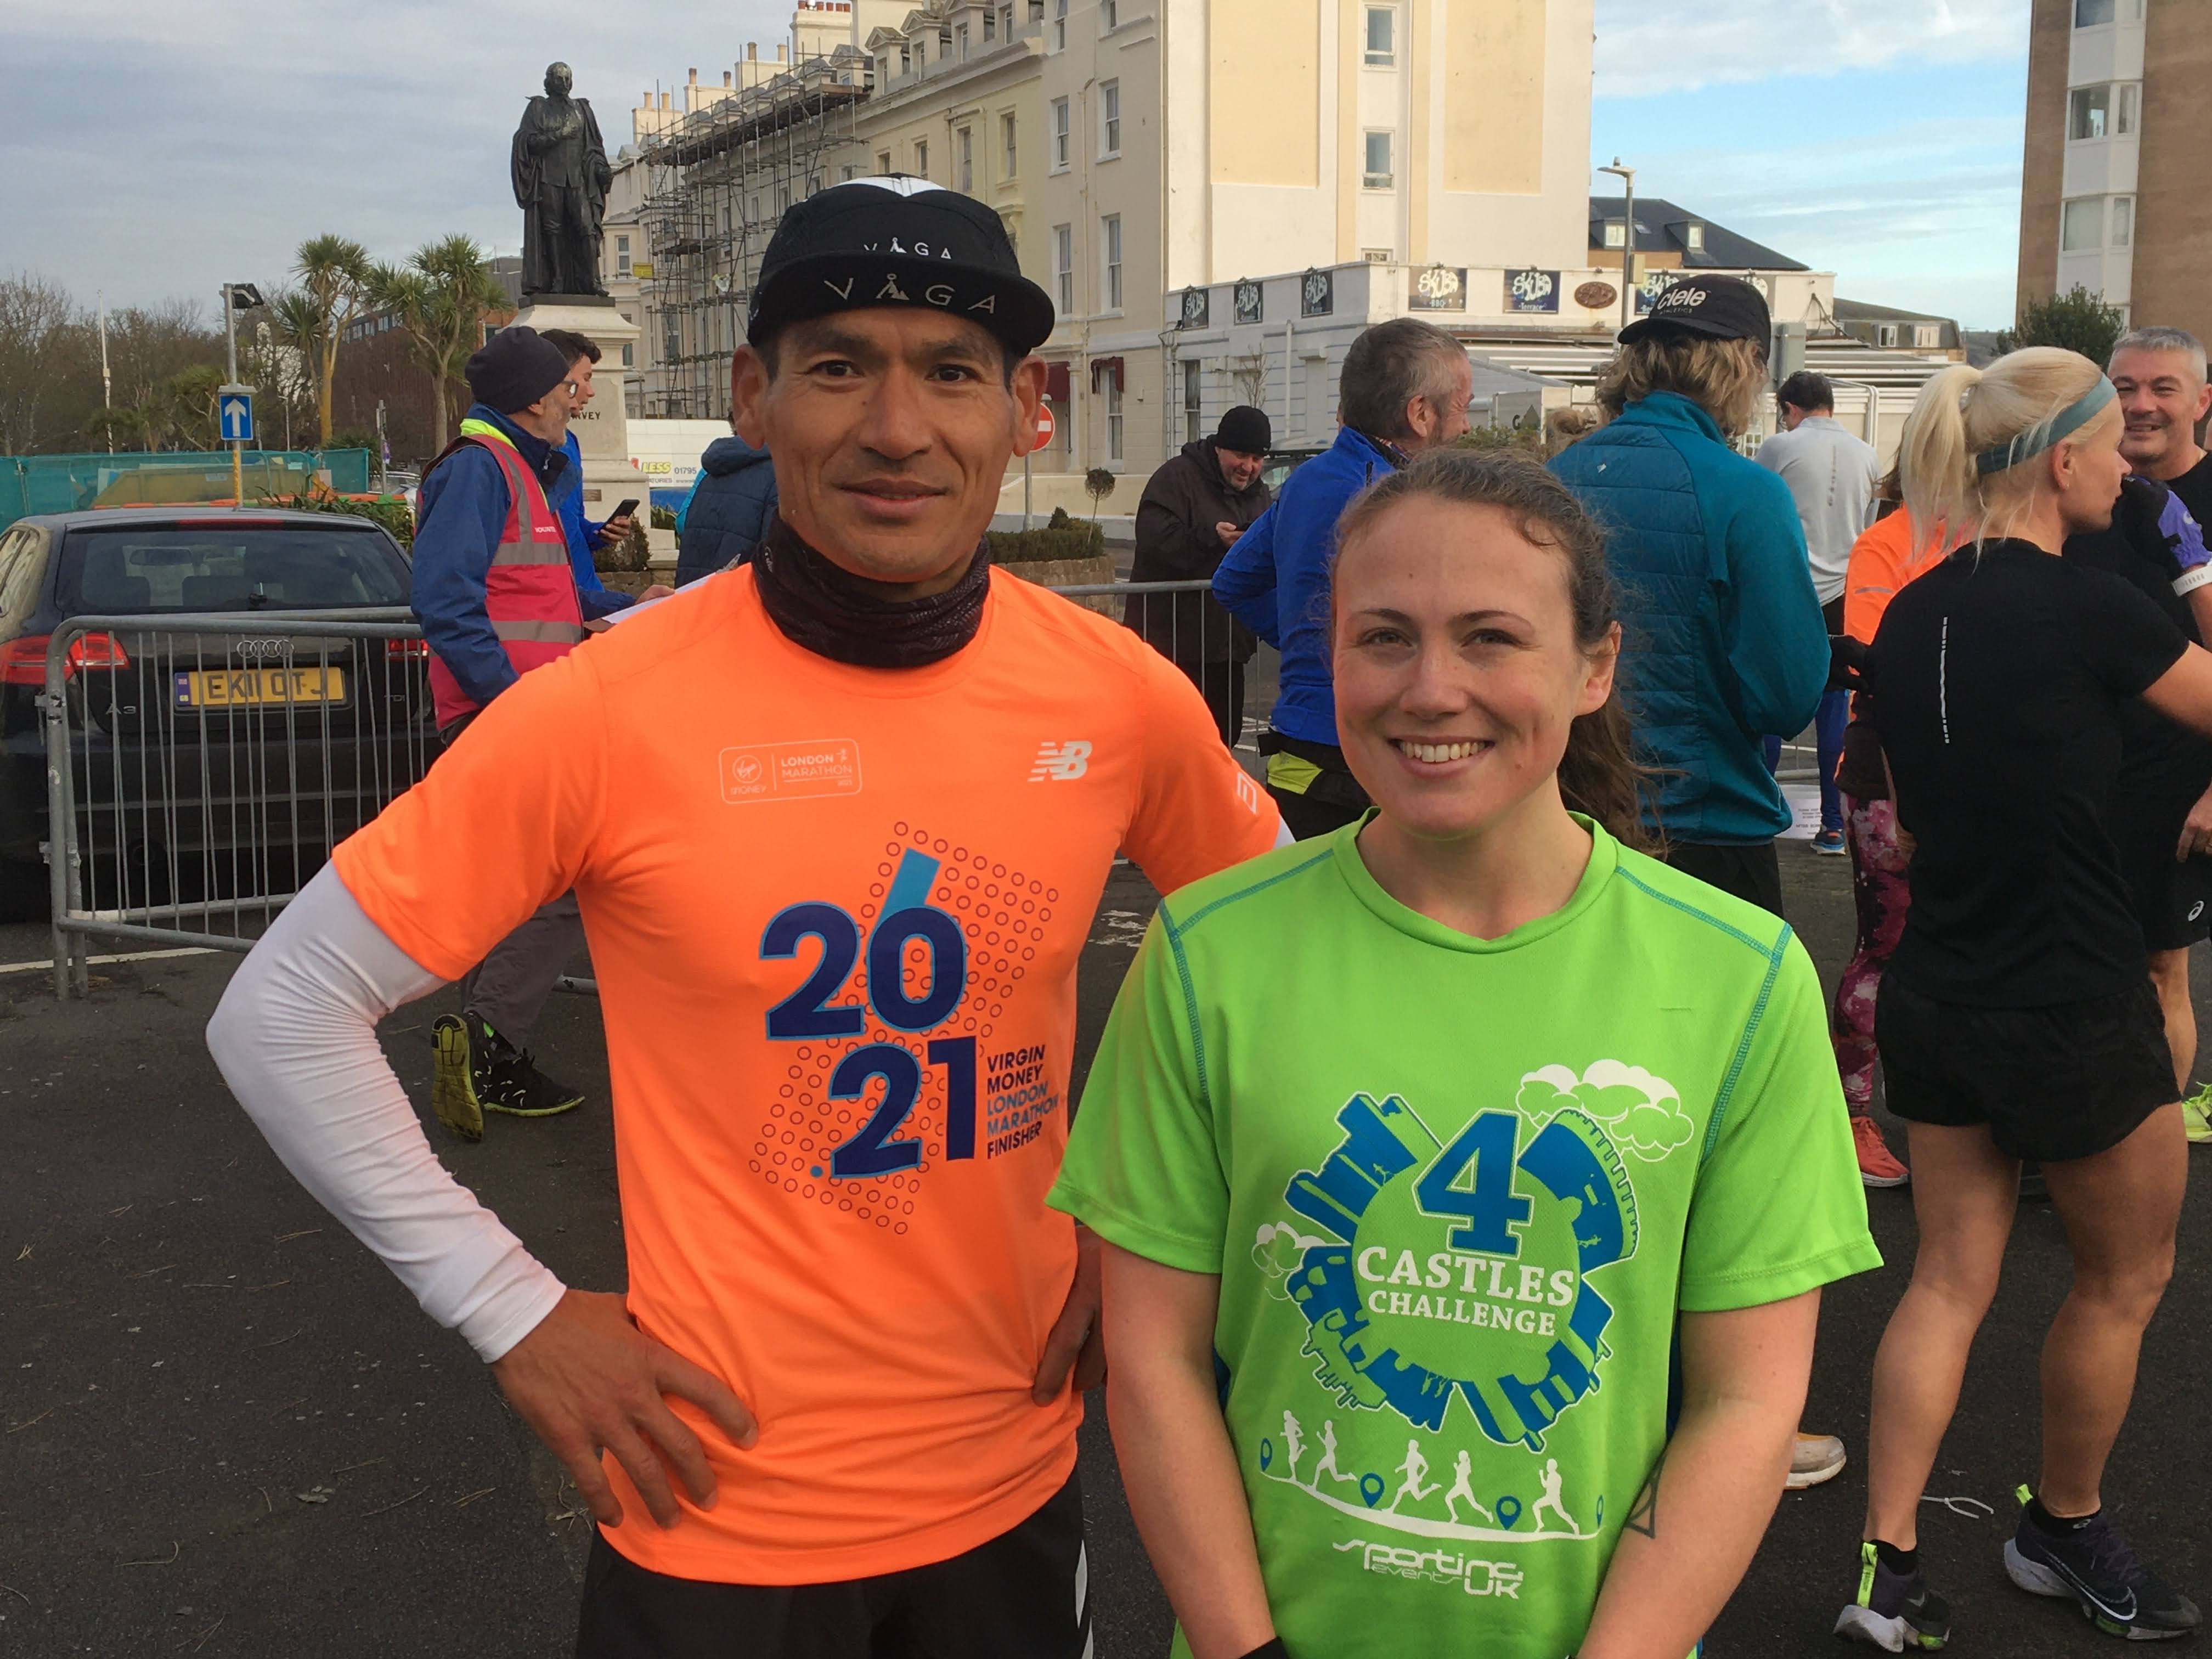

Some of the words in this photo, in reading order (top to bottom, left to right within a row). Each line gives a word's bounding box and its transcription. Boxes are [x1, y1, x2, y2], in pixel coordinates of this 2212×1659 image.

[1418, 269, 1459, 299] SKUBA
[1512, 272, 1552, 301] SKUBA
[641, 462, 671, 474] LESS
[781, 754, 834, 768] LONDON
[781, 765, 853, 778] MARATHON
[987, 1044, 1046, 1073] VIRGIN
[987, 1064, 1043, 1095] MONEY
[988, 1080, 1049, 1116] LONDON
[987, 1092, 1059, 1137] MARATHON
[987, 1121, 1042, 1160] FINISHER
[1412, 1107, 1534, 1260] 4
[1357, 1246, 1574, 1307] CASTLES
[1368, 1290, 1556, 1336] CHALLENGE
